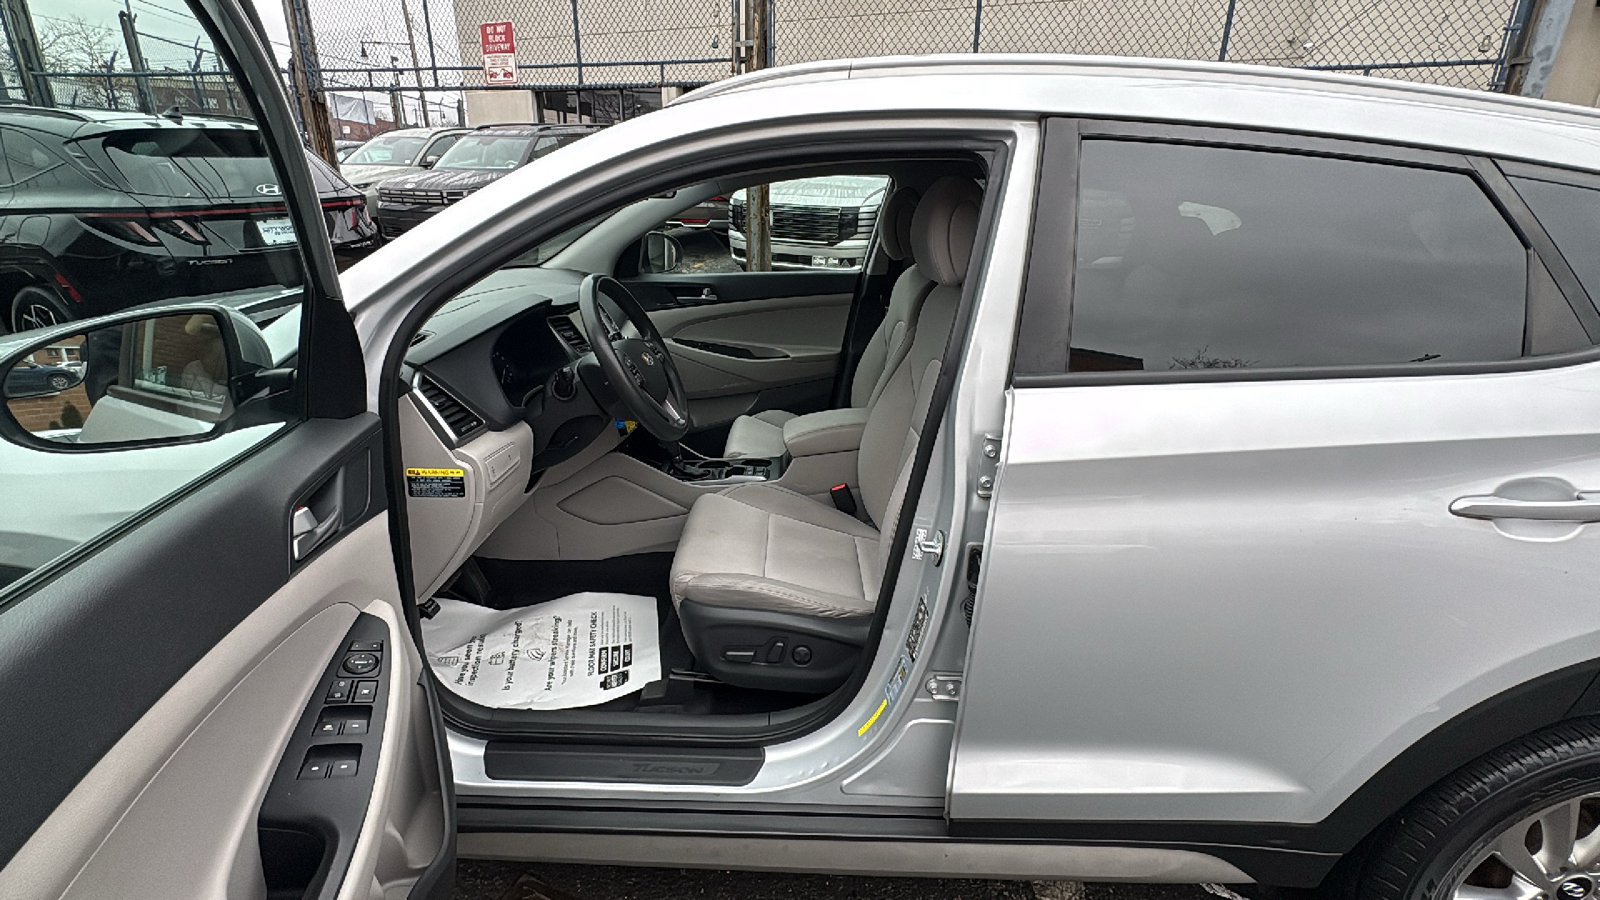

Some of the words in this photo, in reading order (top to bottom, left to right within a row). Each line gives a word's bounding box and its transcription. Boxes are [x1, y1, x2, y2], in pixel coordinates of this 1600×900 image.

[486, 26, 494, 34] DO
[496, 25, 506, 33] NOT
[488, 34, 506, 42] BLOCK
[485, 43, 511, 52] DRIVEWAY
[551, 615, 563, 646] streaking?
[589, 629, 597, 648] SAFETY
[464, 644, 473, 661] seen
[506, 648, 520, 671] battery
[548, 646, 558, 666] wipers
[465, 656, 482, 686] inspection
[505, 671, 514, 685] your
[548, 667, 556, 680] your
[544, 681, 553, 691] Are
